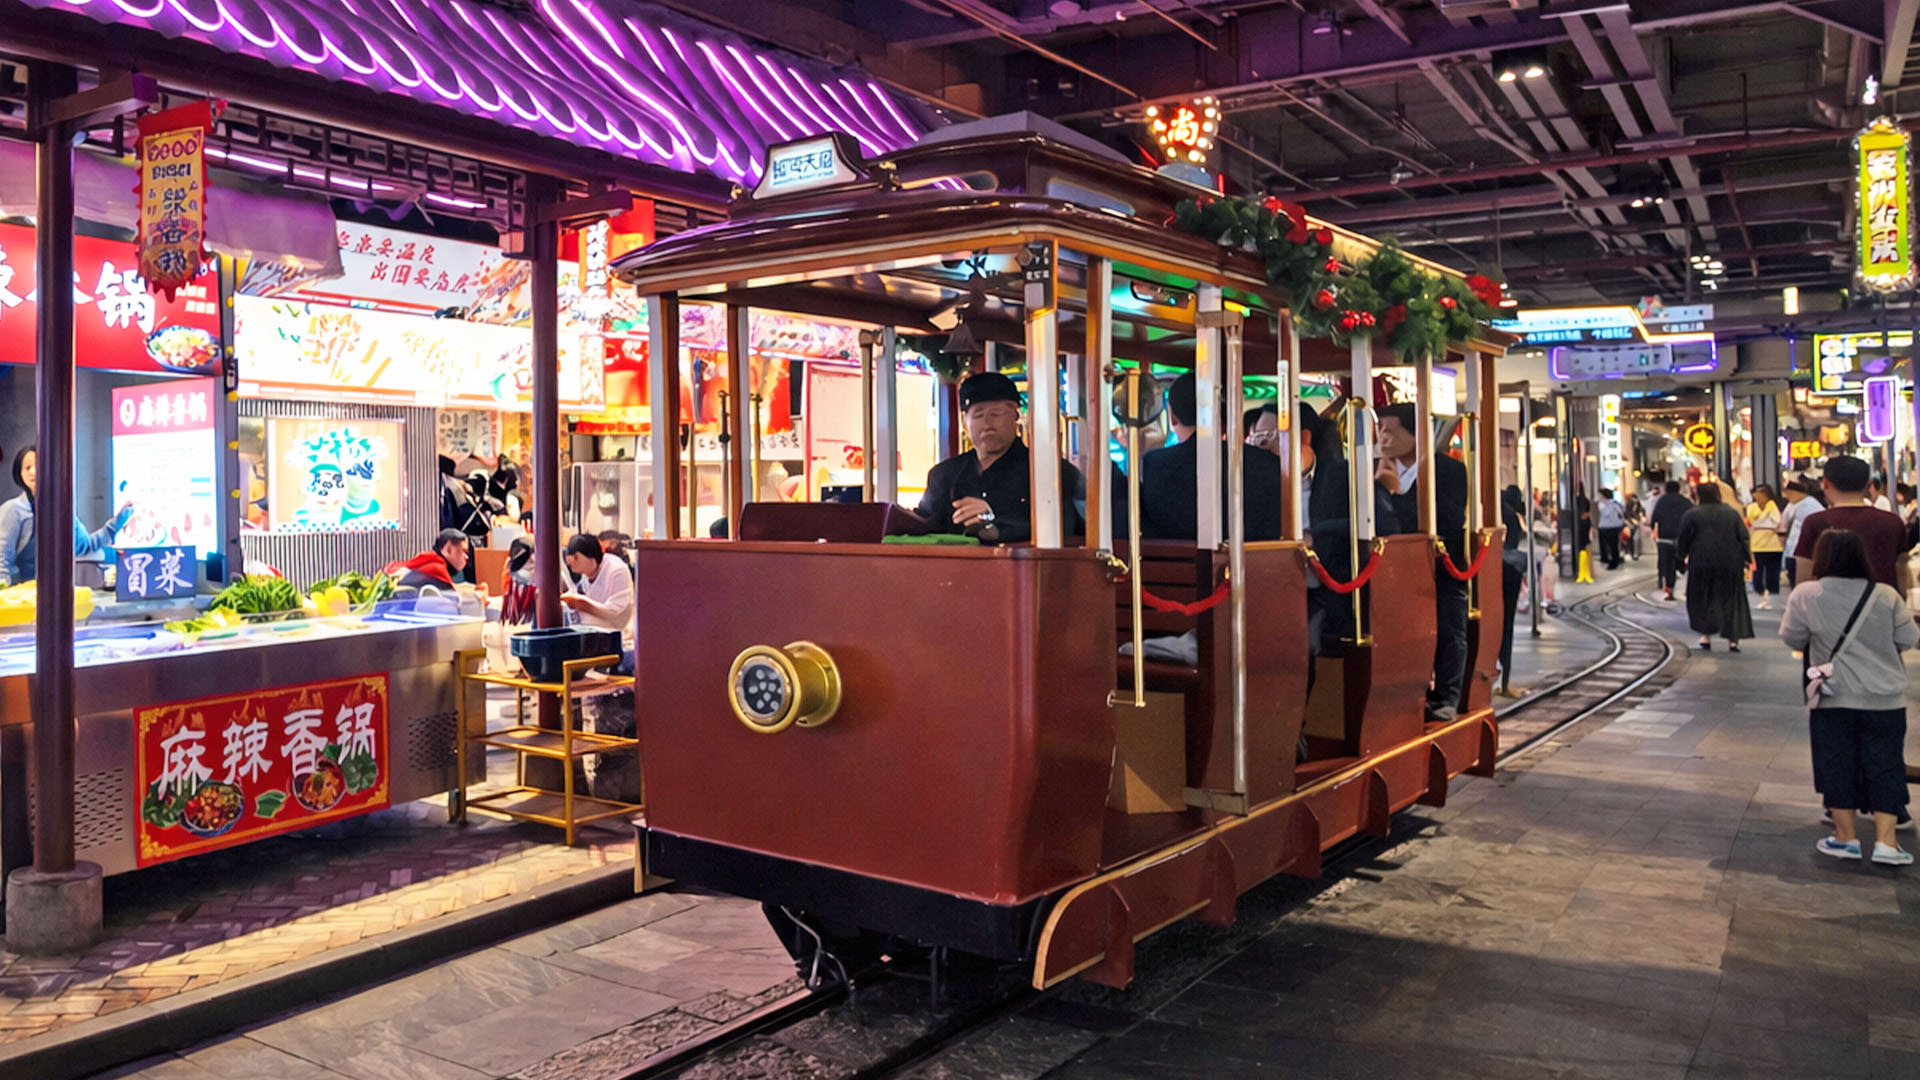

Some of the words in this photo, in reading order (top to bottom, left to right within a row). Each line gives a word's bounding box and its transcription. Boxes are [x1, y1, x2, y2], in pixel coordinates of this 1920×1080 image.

[124, 550, 194, 596] 冒菜
[157, 703, 376, 801] 麻辣香锅
